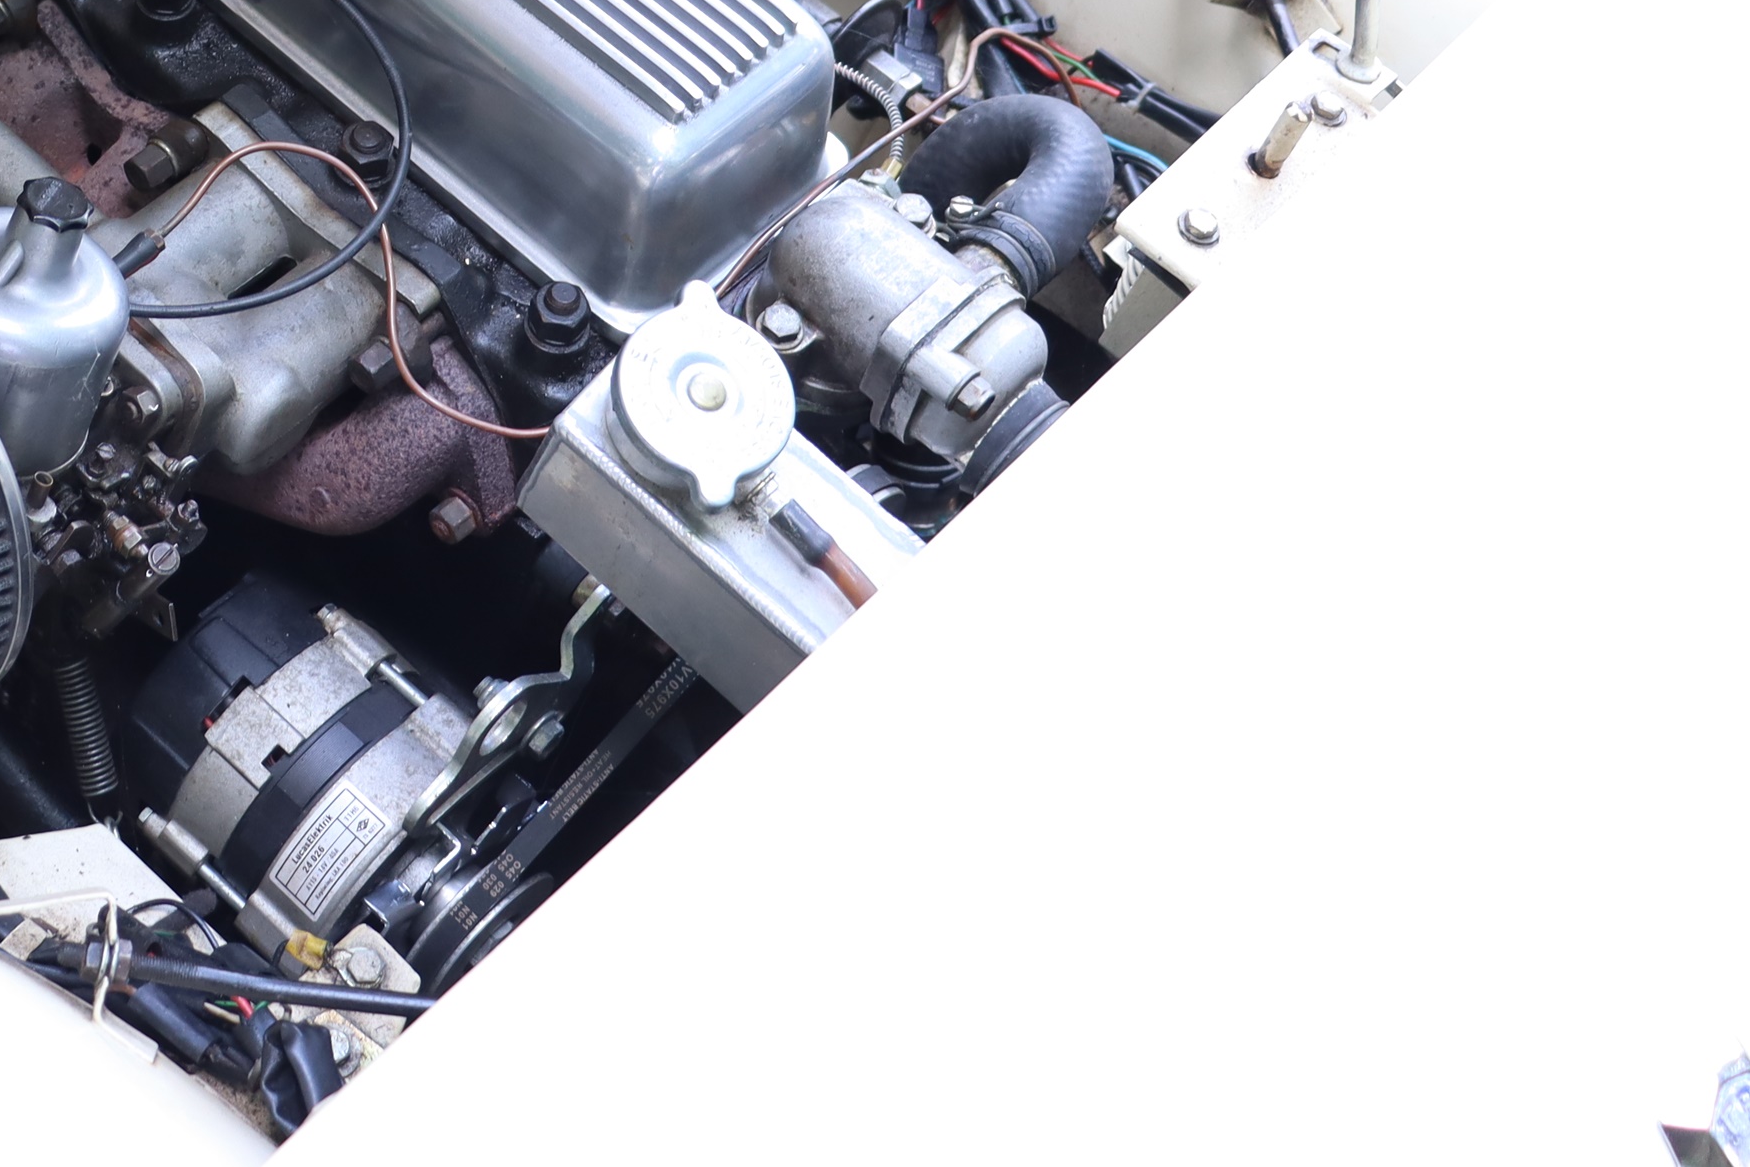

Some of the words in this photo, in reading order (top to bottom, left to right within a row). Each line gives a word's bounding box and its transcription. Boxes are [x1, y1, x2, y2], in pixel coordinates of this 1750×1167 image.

[643, 661, 695, 719] V10X975
[548, 781, 583, 819] RESISTANT
[561, 804, 579, 823] BELT
[291, 814, 333, 865] LucasElektrik
[302, 860, 313, 874] 24
[311, 845, 325, 862] 026
[481, 873, 498, 891] 030
[488, 880, 506, 898] 029
[453, 905, 471, 923] N01
[460, 911, 479, 930] N01
